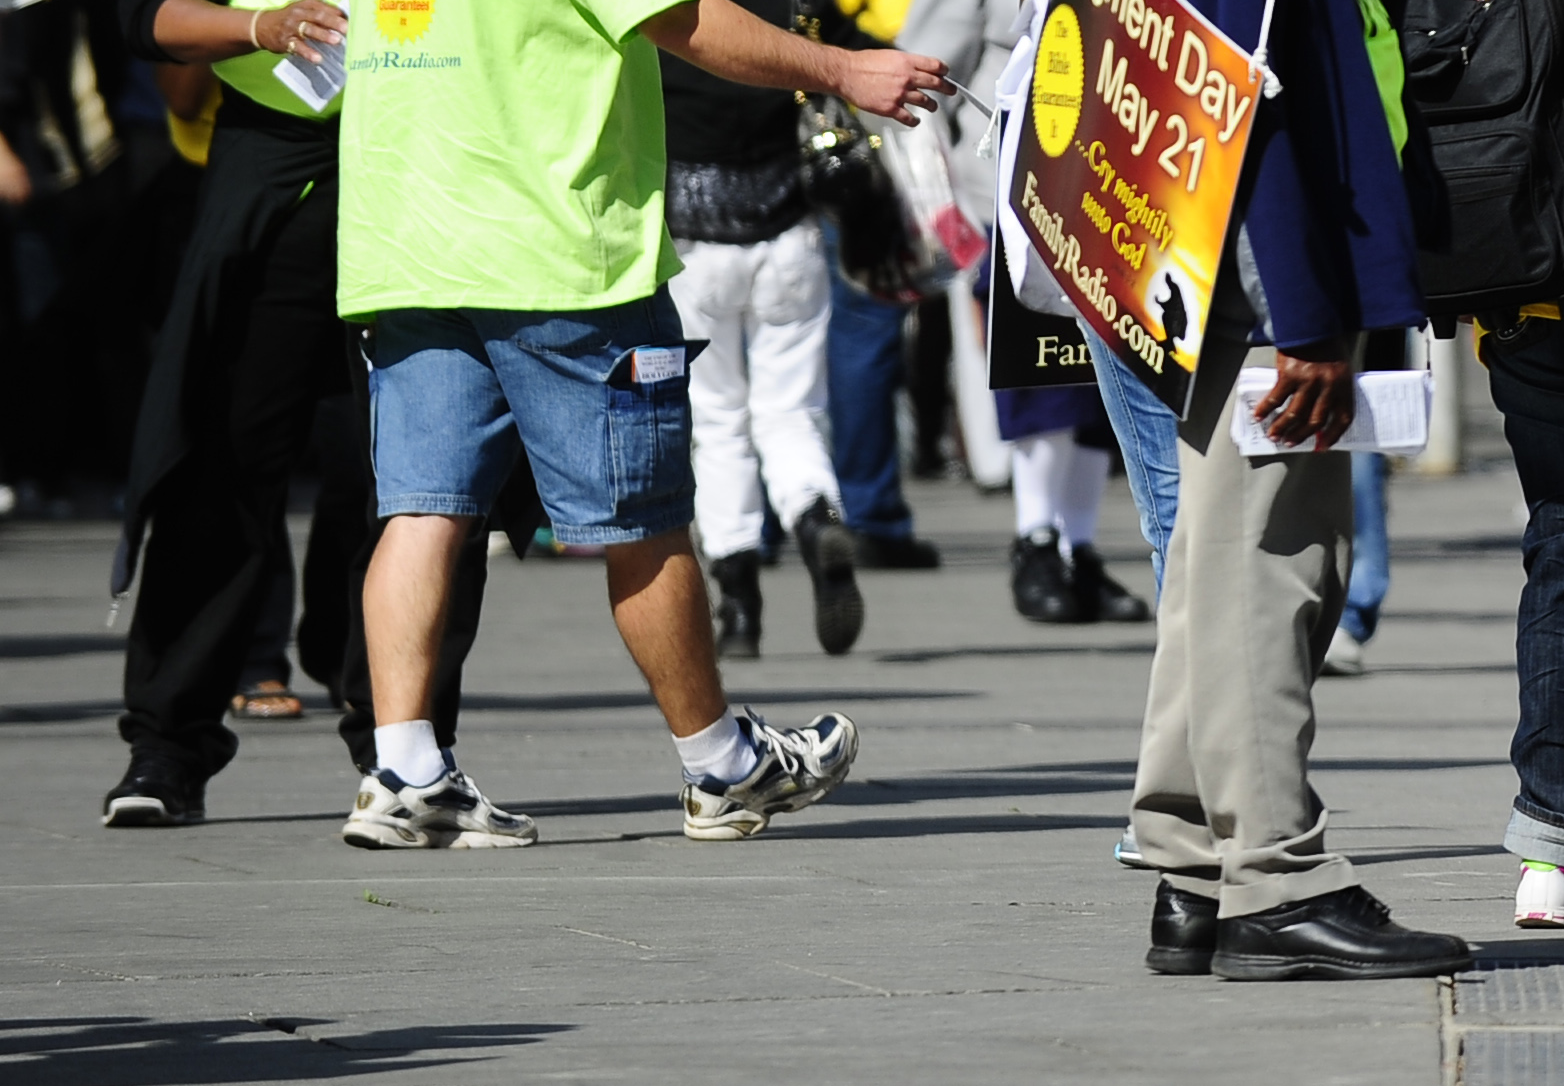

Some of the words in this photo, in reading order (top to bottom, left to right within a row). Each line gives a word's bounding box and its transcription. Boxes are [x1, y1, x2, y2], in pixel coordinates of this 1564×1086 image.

[350, 51, 462, 73] amilyRadio.com
[1055, 20, 1069, 39] The
[1096, 38, 1160, 157] May
[1157, 113, 1206, 194] 21
[1174, 28, 1251, 144] Day
[1111, 220, 1149, 272] God
[1113, 170, 1173, 253] mightily
[1022, 170, 1166, 375] FamilyRadio.com
